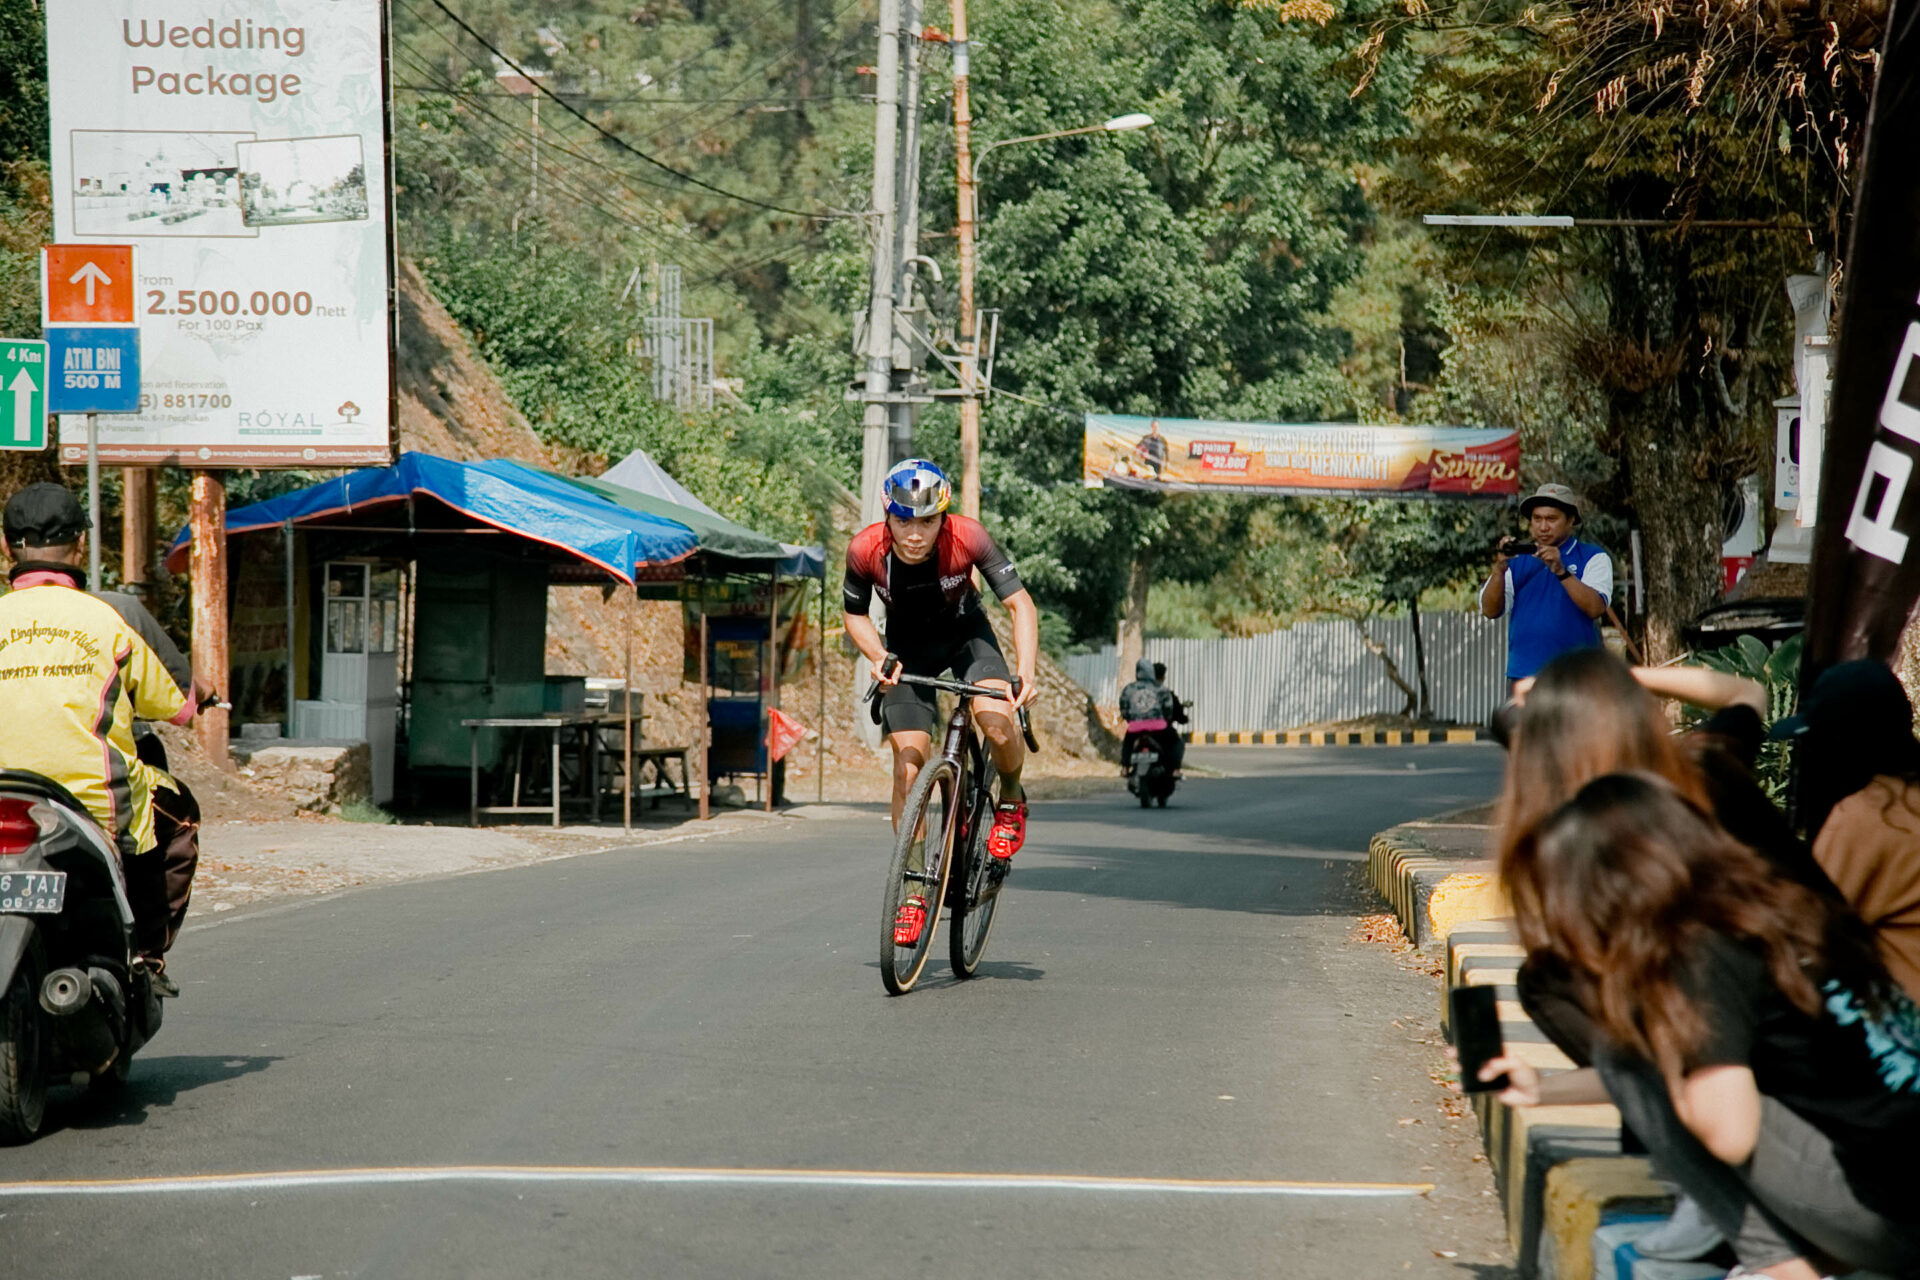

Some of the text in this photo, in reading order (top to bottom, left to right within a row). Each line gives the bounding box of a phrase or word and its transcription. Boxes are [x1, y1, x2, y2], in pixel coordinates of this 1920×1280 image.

[123, 18, 306, 56] Wedding
[132, 66, 301, 103] Package
[146, 289, 313, 316] 2.500.000
[178, 319, 264, 331] For 100 Pax
[7, 347, 42, 363] 4 Km
[64, 347, 121, 370] ATM BNI
[64, 375, 121, 389] 500 M
[163, 393, 232, 409] 881700
[1432, 452, 1516, 490] Surya
[10, 620, 70, 645] Lingkungan
[0, 665, 40, 680] UPATEN
[1, 875, 60, 893] 6 TAI
